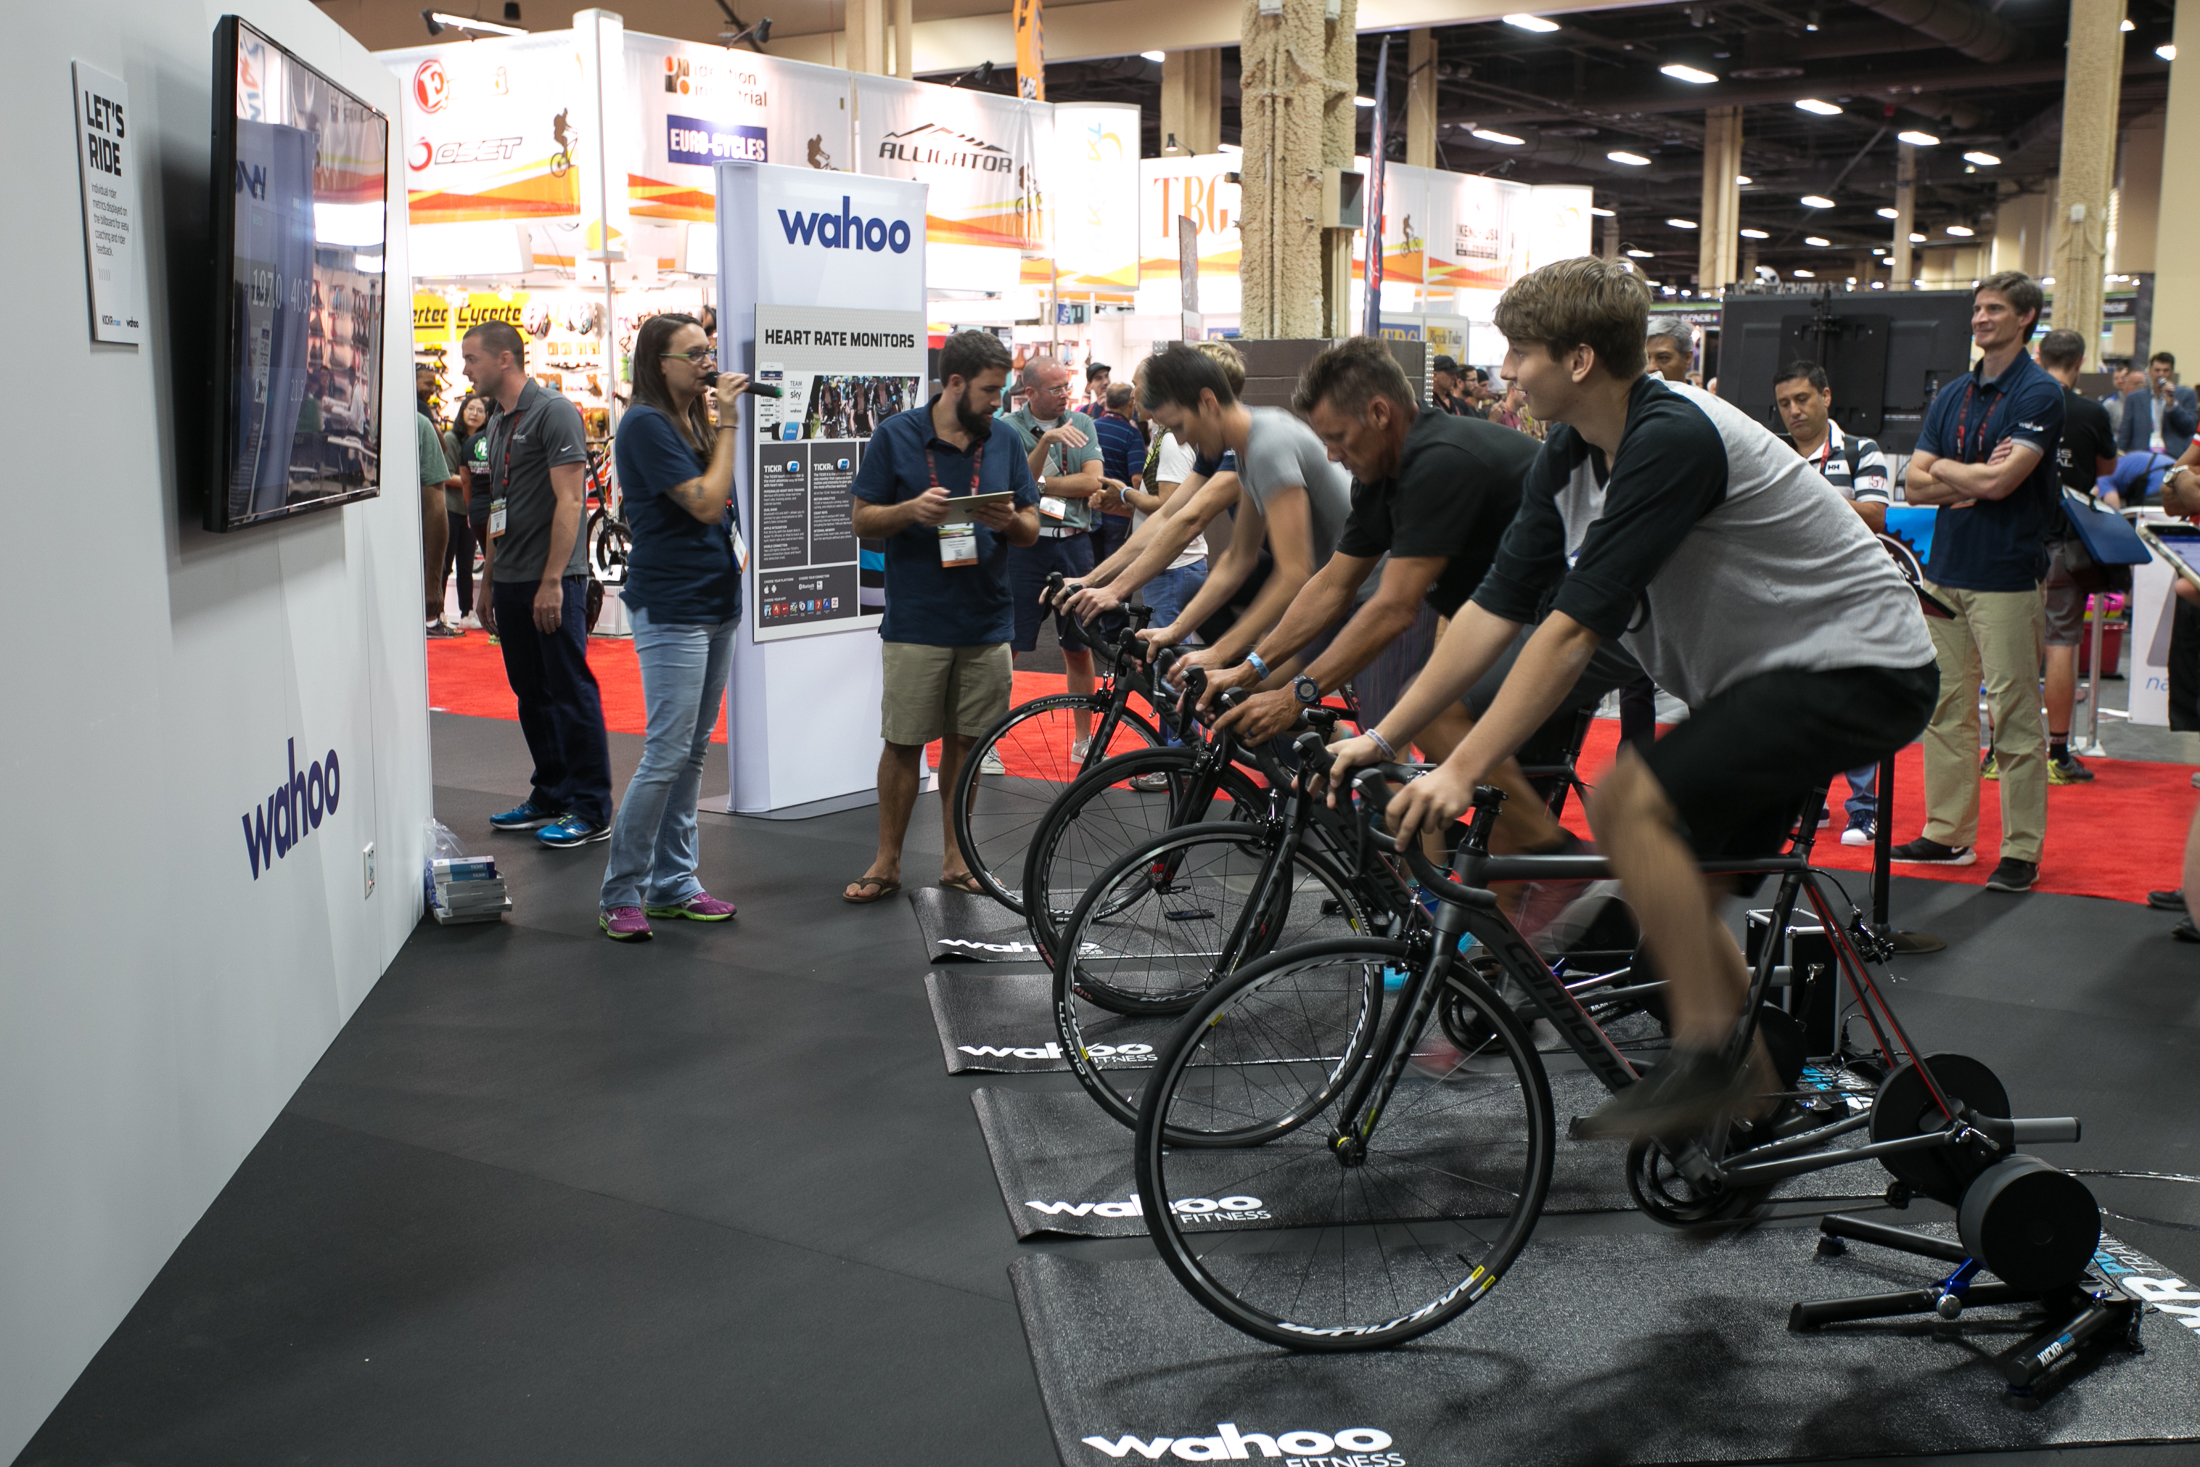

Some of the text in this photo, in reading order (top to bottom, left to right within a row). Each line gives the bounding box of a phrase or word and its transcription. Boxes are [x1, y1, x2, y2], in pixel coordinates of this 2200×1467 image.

[85, 90, 125, 139] LET'S
[88, 132, 122, 177] RIDE
[669, 128, 766, 161] EURO-CYCLES
[879, 142, 1013, 173] ALLIGATOR
[1154, 174, 1229, 237] TBG
[778, 195, 911, 254] wahoo
[413, 304, 521, 325] ertec Cycerte
[765, 329, 915, 348] HEART RATE MONITORS
[790, 390, 802, 400] sky
[764, 464, 783, 473] TICKR
[242, 737, 340, 881] wahoo
[937, 938, 1101, 954] waho
[1058, 1001, 1086, 1075] LUGANO
[1180, 1210, 1272, 1224] FITNESS
[2036, 1341, 2063, 1367] KICKR
[1082, 1422, 1393, 1462] wahoo
[1285, 1452, 1406, 1467] FITNESS
